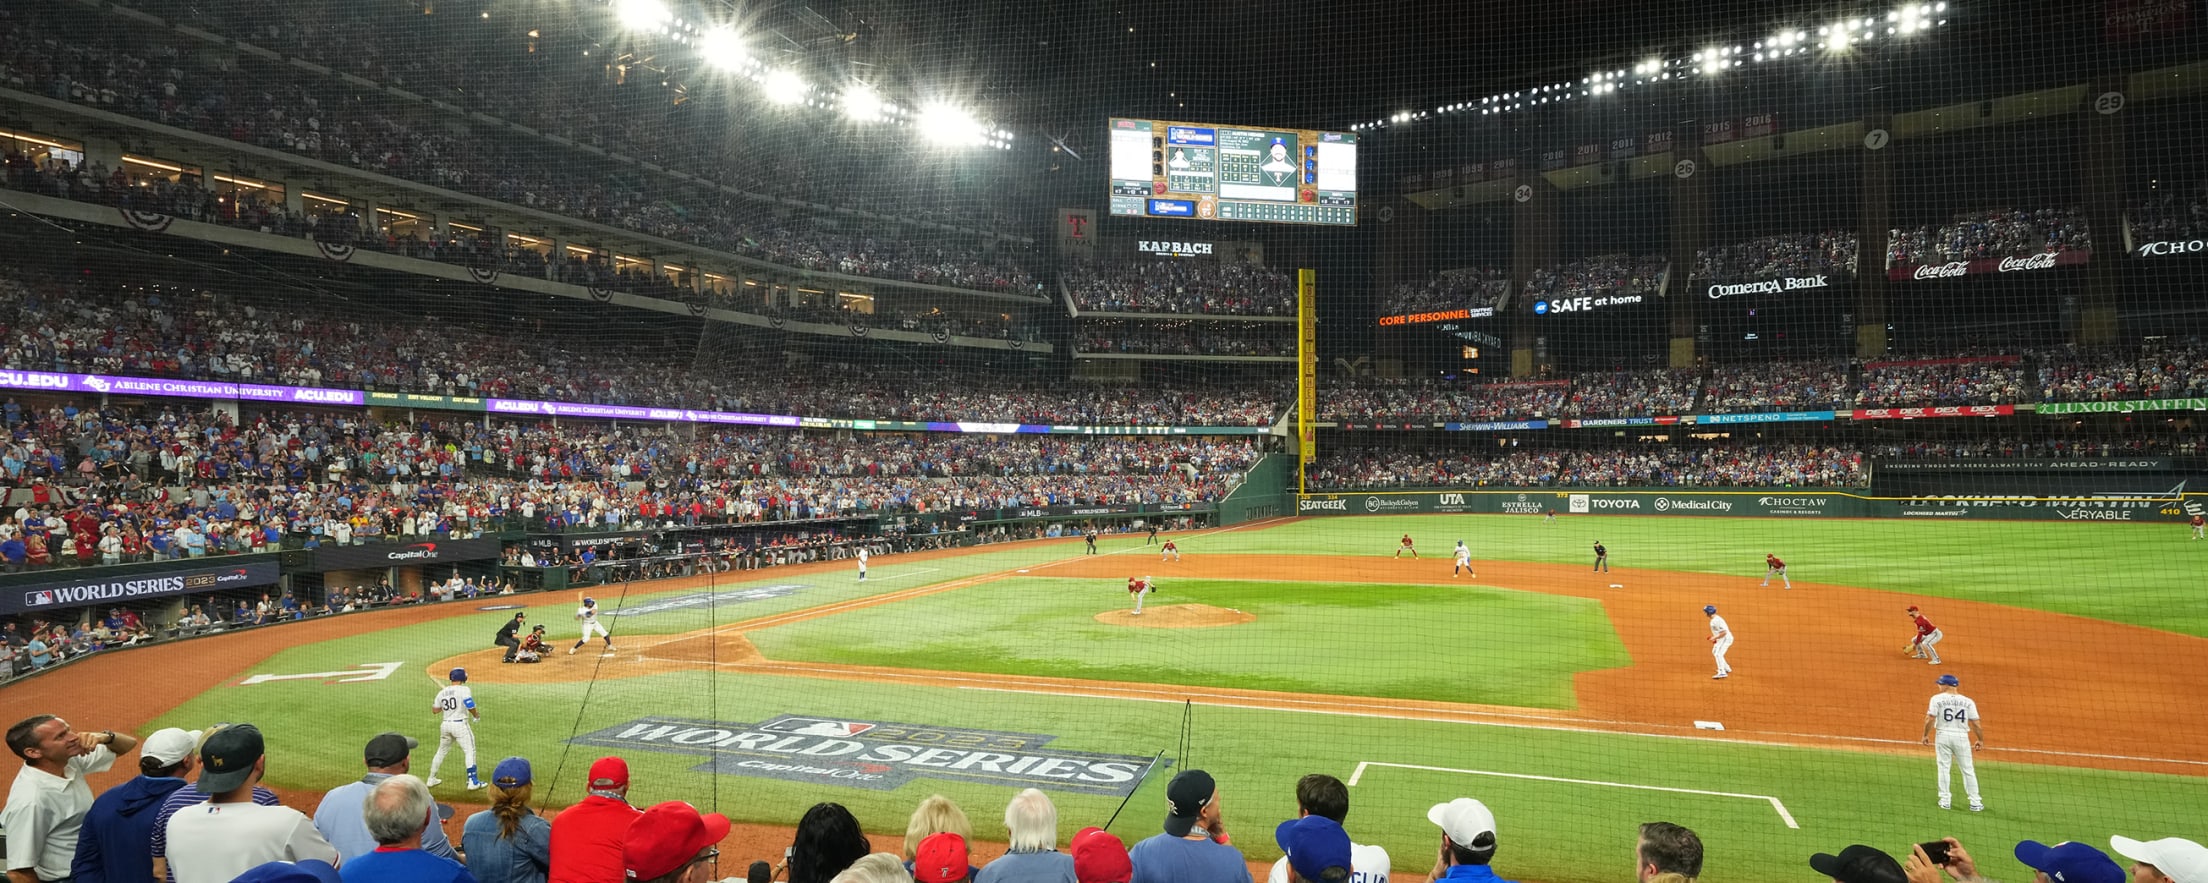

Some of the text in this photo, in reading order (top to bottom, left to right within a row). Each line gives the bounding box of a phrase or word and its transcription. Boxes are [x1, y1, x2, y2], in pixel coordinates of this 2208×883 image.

[2099, 97, 2122, 109] 29
[1745, 114, 1772, 127] 2016
[1705, 121, 1731, 134] 2015
[1648, 130, 1673, 143] 2012
[1873, 133, 1882, 145] 7
[1577, 144, 1599, 155] 2011
[1612, 139, 1634, 150] 2011
[1677, 163, 1694, 175] 26
[1516, 187, 1531, 199] 34
[1138, 241, 1213, 254] KARBACH
[1784, 274, 1828, 291] Bank
[1551, 297, 1592, 314] SAFE
[1610, 295, 1642, 305] home
[1379, 309, 1470, 326] CORE PERSONNEL
[114, 380, 163, 392] ABILENE
[163, 383, 222, 396] CHRISTIAN
[223, 387, 284, 398] UNIVERSITY
[295, 389, 354, 402] ACU.EDU
[1971, 405, 1997, 413] DEX
[2054, 401, 2120, 413] LUXOR
[1722, 414, 1780, 422] NETSPEND
[1300, 499, 1346, 510] SEATGEEK
[1440, 494, 1465, 505] UTA
[1592, 500, 1640, 509] TOYOTA
[1765, 497, 1827, 506] CHOCTAW
[1672, 500, 1733, 512] Medical City
[581, 538, 604, 546] WORLD
[54, 582, 124, 604] WORLD
[123, 576, 184, 597] SERIES
[186, 576, 216, 587] 2023
[441, 697, 457, 710] 30
[1944, 708, 1966, 723] 64
[618, 722, 1142, 784] WORLD SERIES
